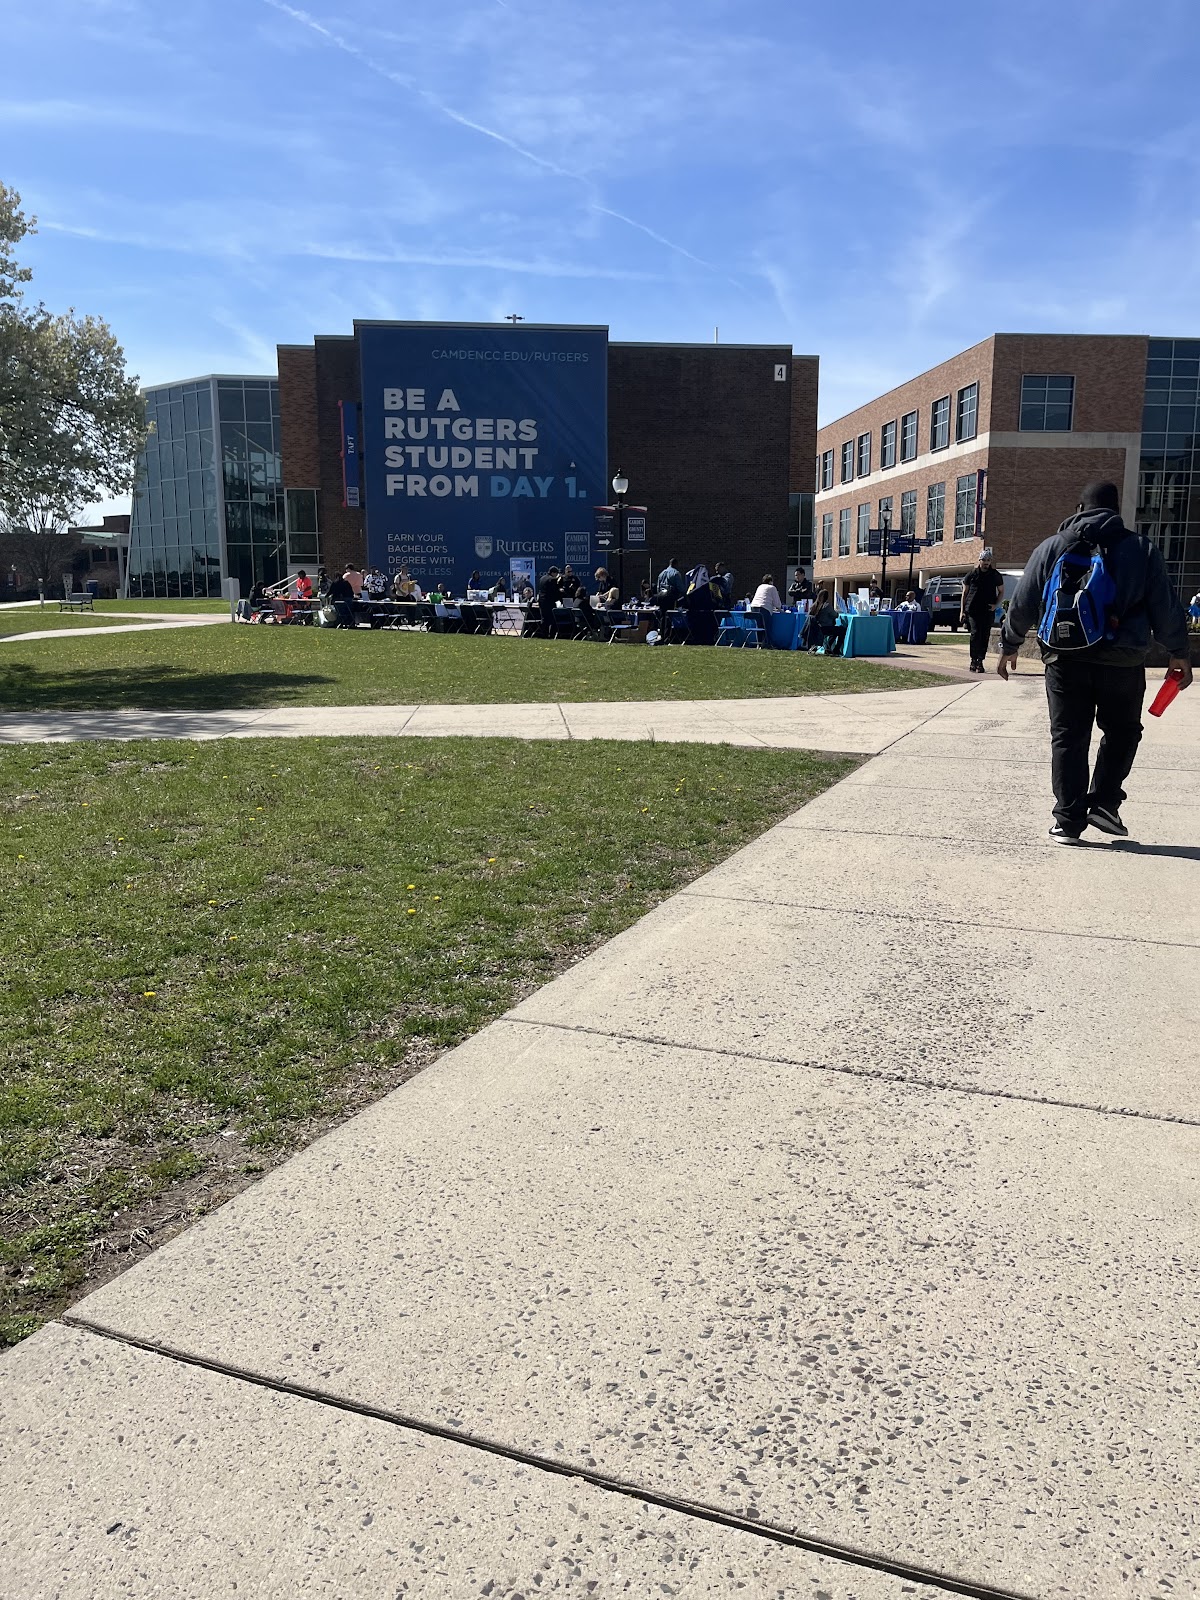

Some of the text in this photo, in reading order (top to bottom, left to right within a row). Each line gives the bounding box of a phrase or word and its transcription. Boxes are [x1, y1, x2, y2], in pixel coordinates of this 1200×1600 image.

[431, 350, 589, 362] CAMDENCC.EDU/RUTGERS
[777, 367, 783, 378] 4
[383, 388, 461, 411] BE A
[384, 417, 538, 441] RUTGERS
[347, 435, 355, 454] TAFT
[384, 445, 539, 470] STUDENT
[386, 474, 587, 498] FROM DAY 1.
[387, 533, 444, 542] EARN YOUR
[566, 534, 588, 542] CAMDEN
[388, 545, 448, 553] BACHELOR'S
[496, 540, 554, 555] RUTGERS
[566, 544, 588, 552] COUNTY
[388, 556, 455, 564] DEGREE WITH
[566, 554, 588, 562] COLLEGE
